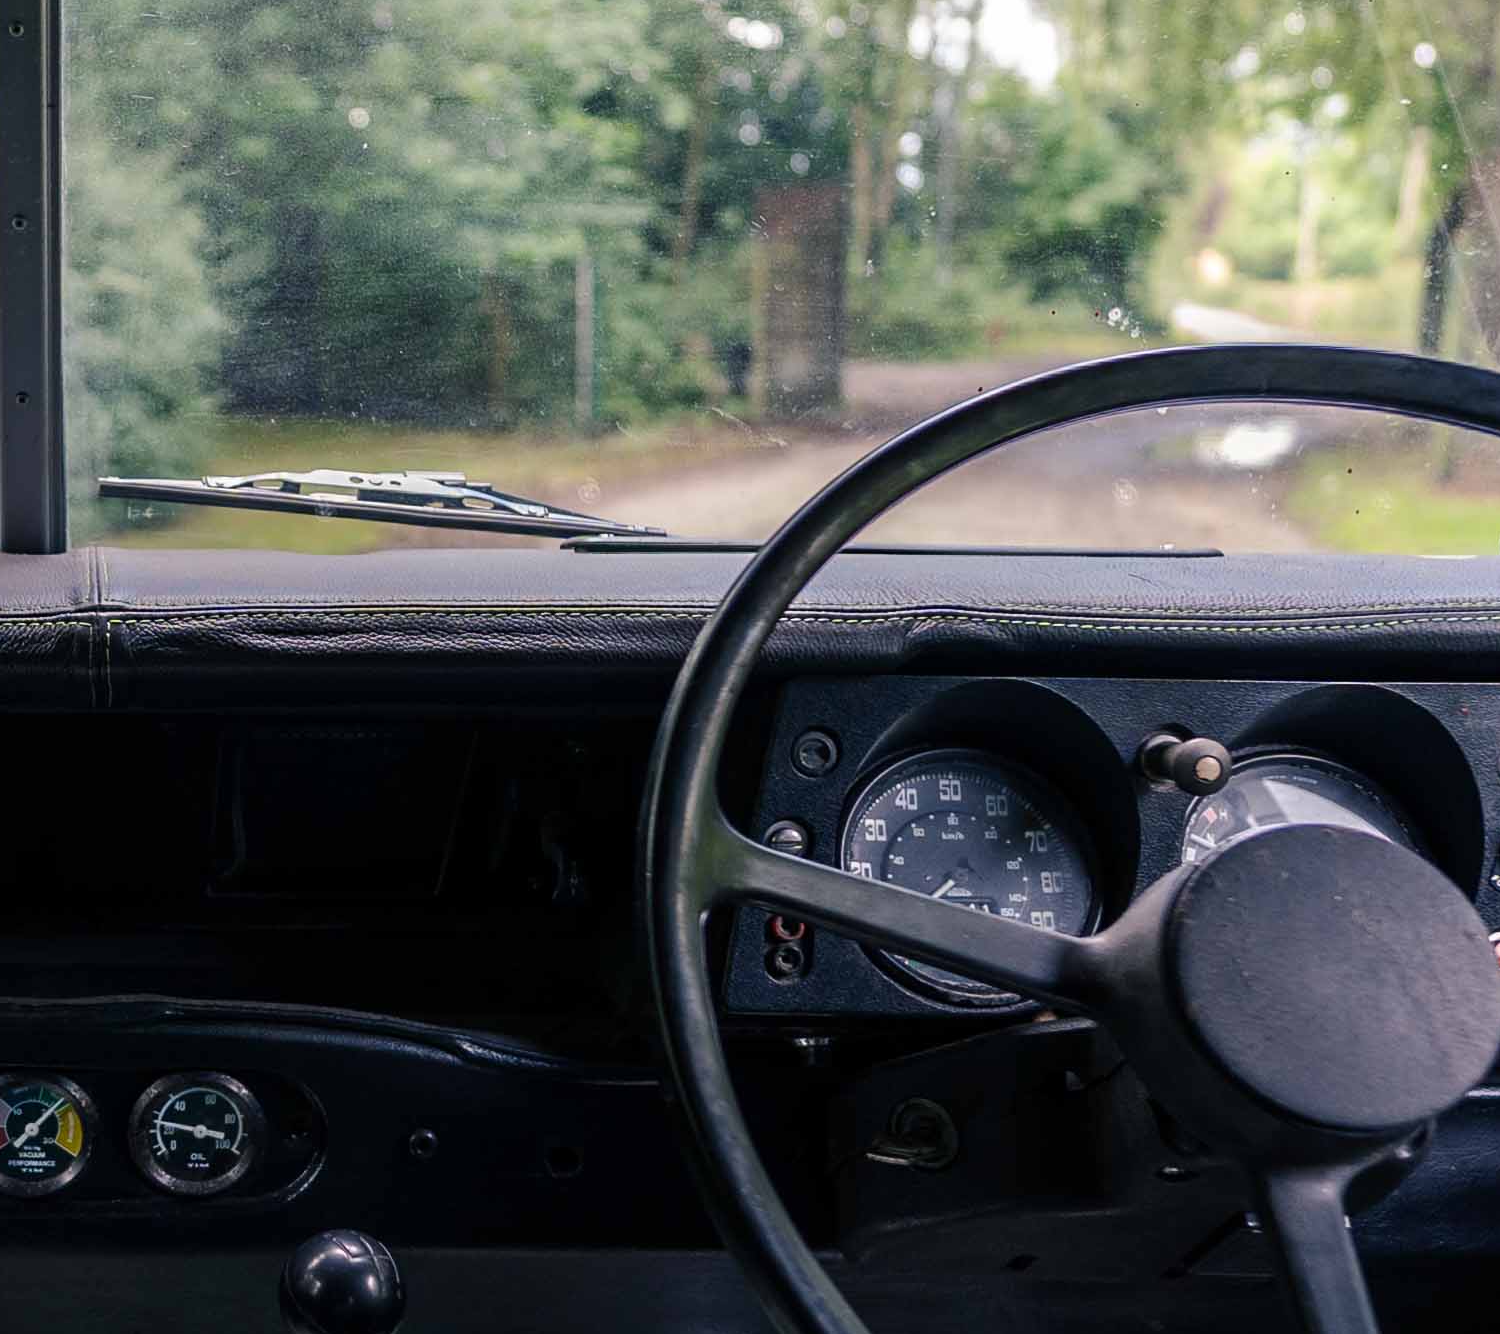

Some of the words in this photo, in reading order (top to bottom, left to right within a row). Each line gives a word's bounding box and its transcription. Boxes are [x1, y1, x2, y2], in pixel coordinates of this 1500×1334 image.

[895, 788, 918, 810] 40
[939, 779, 962, 801] 50
[986, 795, 1008, 816] 60
[865, 819, 887, 841] 30
[942, 832, 965, 840] km/h
[1025, 831, 1047, 852] 70
[1041, 872, 1063, 893] 80
[1031, 911, 1054, 931] 90
[174, 1101, 186, 1111] 40
[170, 1140, 177, 1151] 0
[215, 1139, 231, 1149] 100
[190, 1153, 206, 1161] OIL
